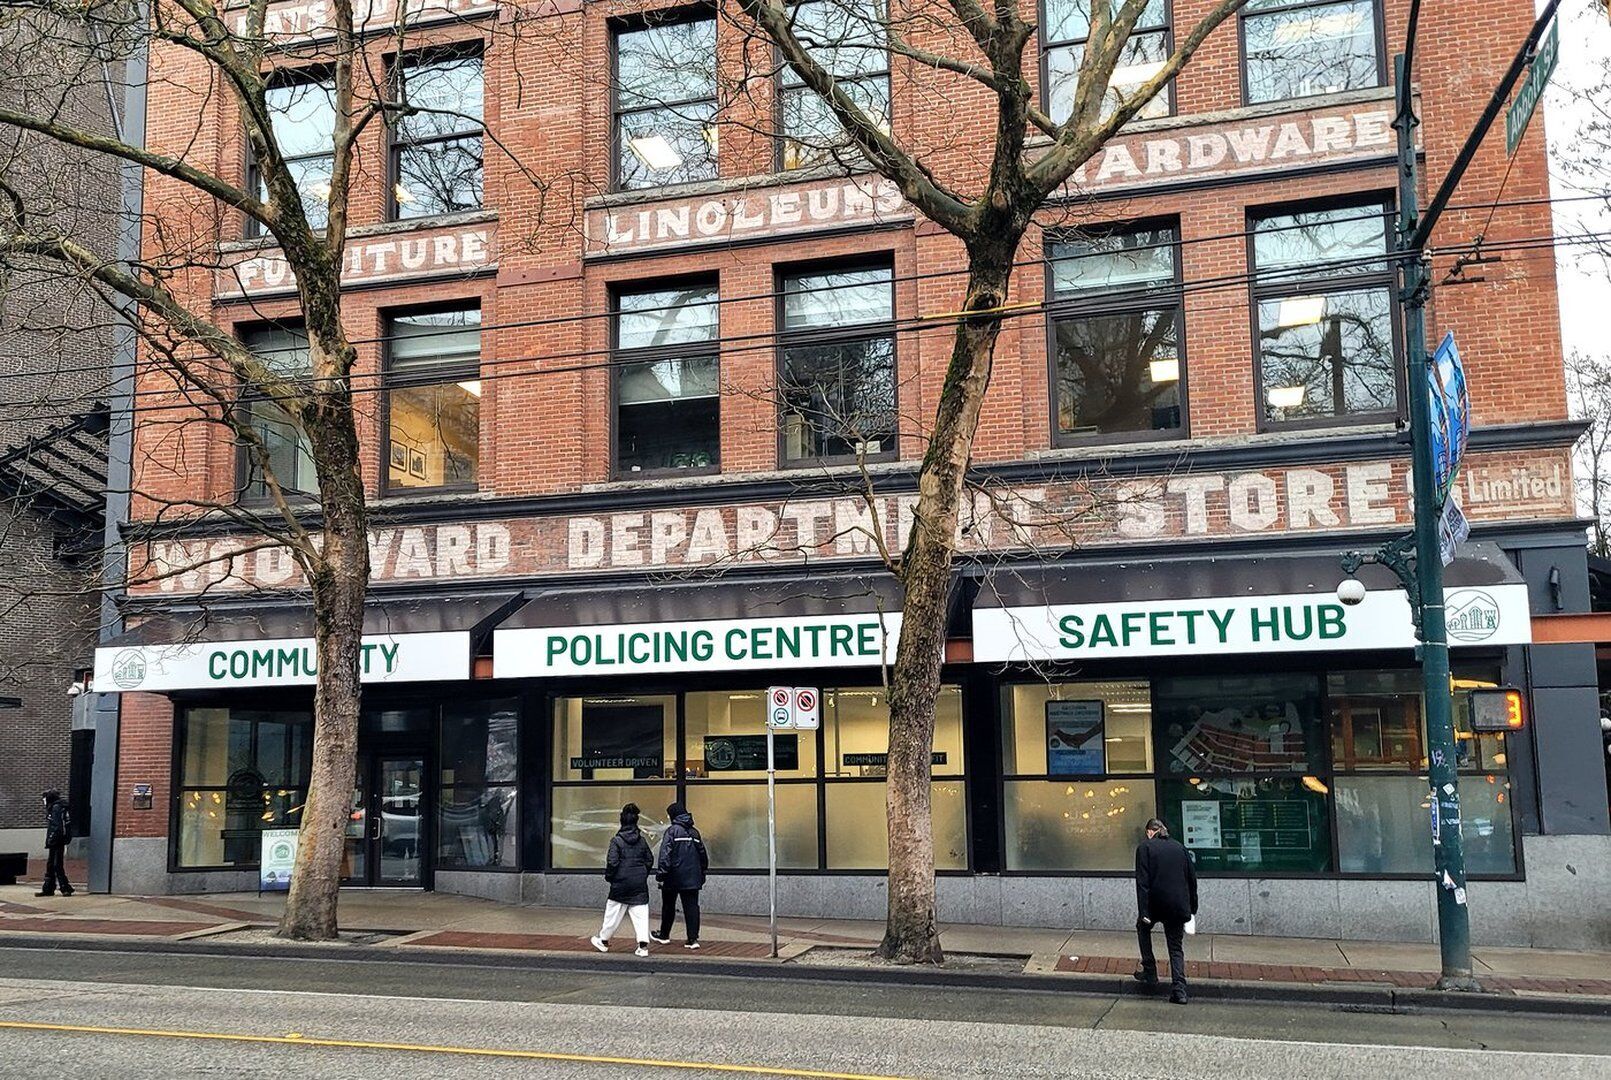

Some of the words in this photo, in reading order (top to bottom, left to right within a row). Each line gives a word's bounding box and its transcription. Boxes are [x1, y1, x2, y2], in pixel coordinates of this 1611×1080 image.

[1510, 65, 1542, 143] Abbott
[1066, 110, 1392, 183] ARDWARE
[604, 180, 903, 244] LINOLEUMS
[237, 230, 488, 289] FUITURE
[1466, 462, 1563, 503] Limited
[208, 642, 400, 681] COMMUTY
[546, 628, 714, 667] POLICING
[724, 622, 881, 661] CENTRE
[1058, 607, 1236, 649] SAFETY
[1250, 603, 1348, 642] HUB
[1505, 691, 1522, 727] 3
[572, 758, 624, 768] VOLUNTEER
[625, 757, 659, 767] DRIVEN
[844, 754, 888, 764] COMMUNIT
[263, 830, 298, 838] WELCOM
